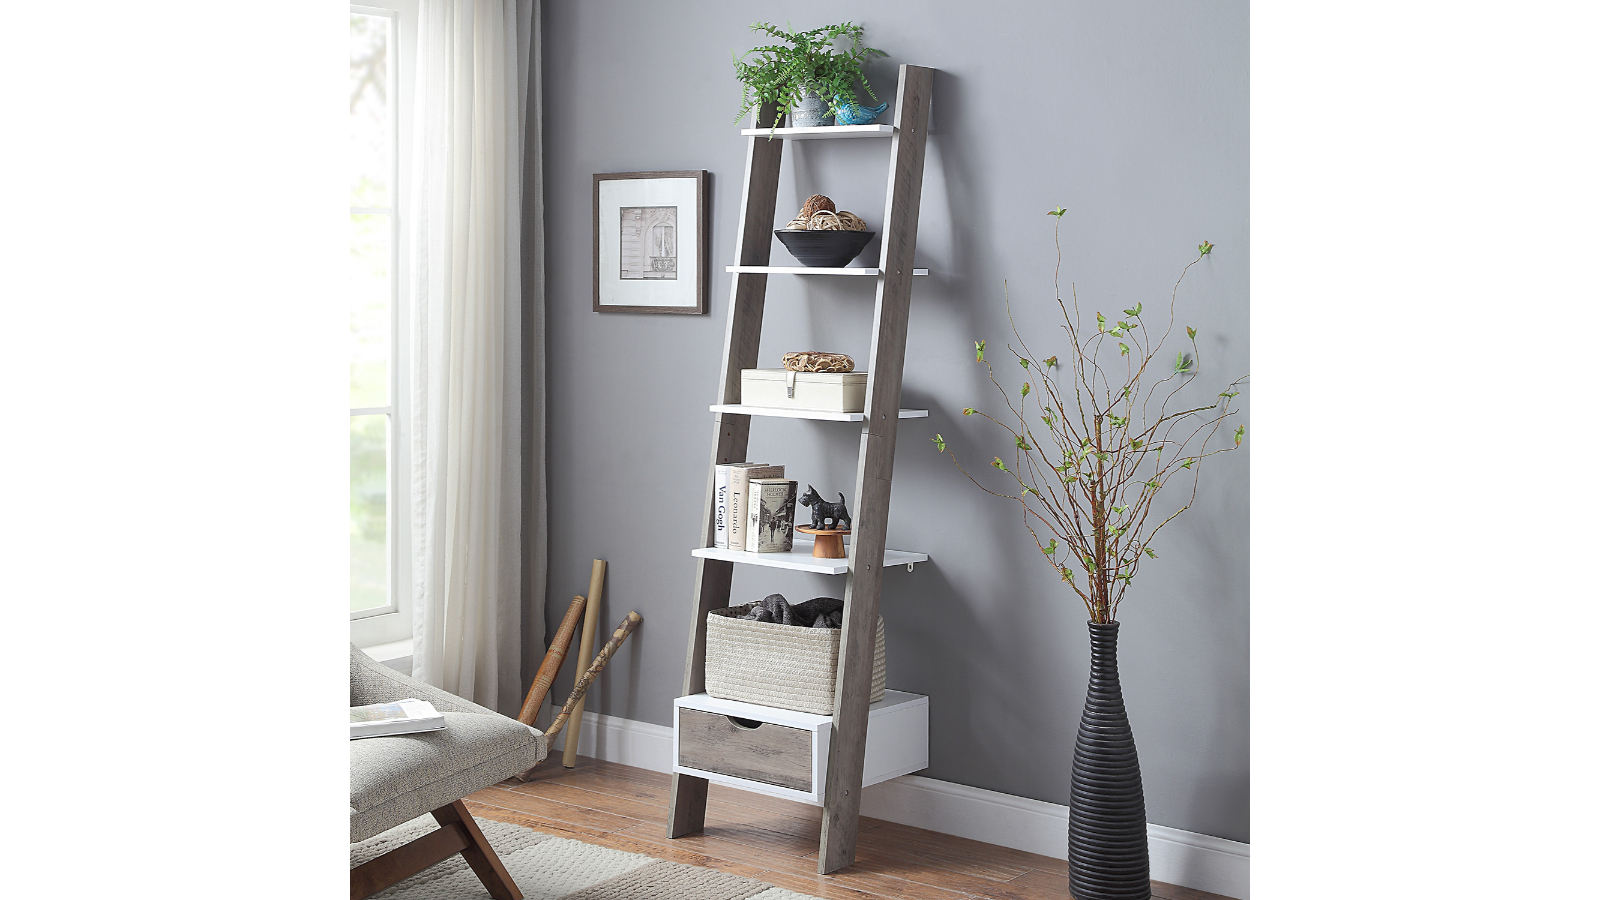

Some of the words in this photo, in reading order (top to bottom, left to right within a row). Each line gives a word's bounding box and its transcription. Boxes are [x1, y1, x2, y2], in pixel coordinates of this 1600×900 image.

[718, 485, 727, 503] Van
[716, 505, 726, 531] Gogh
[732, 492, 741, 534] Leonardo
